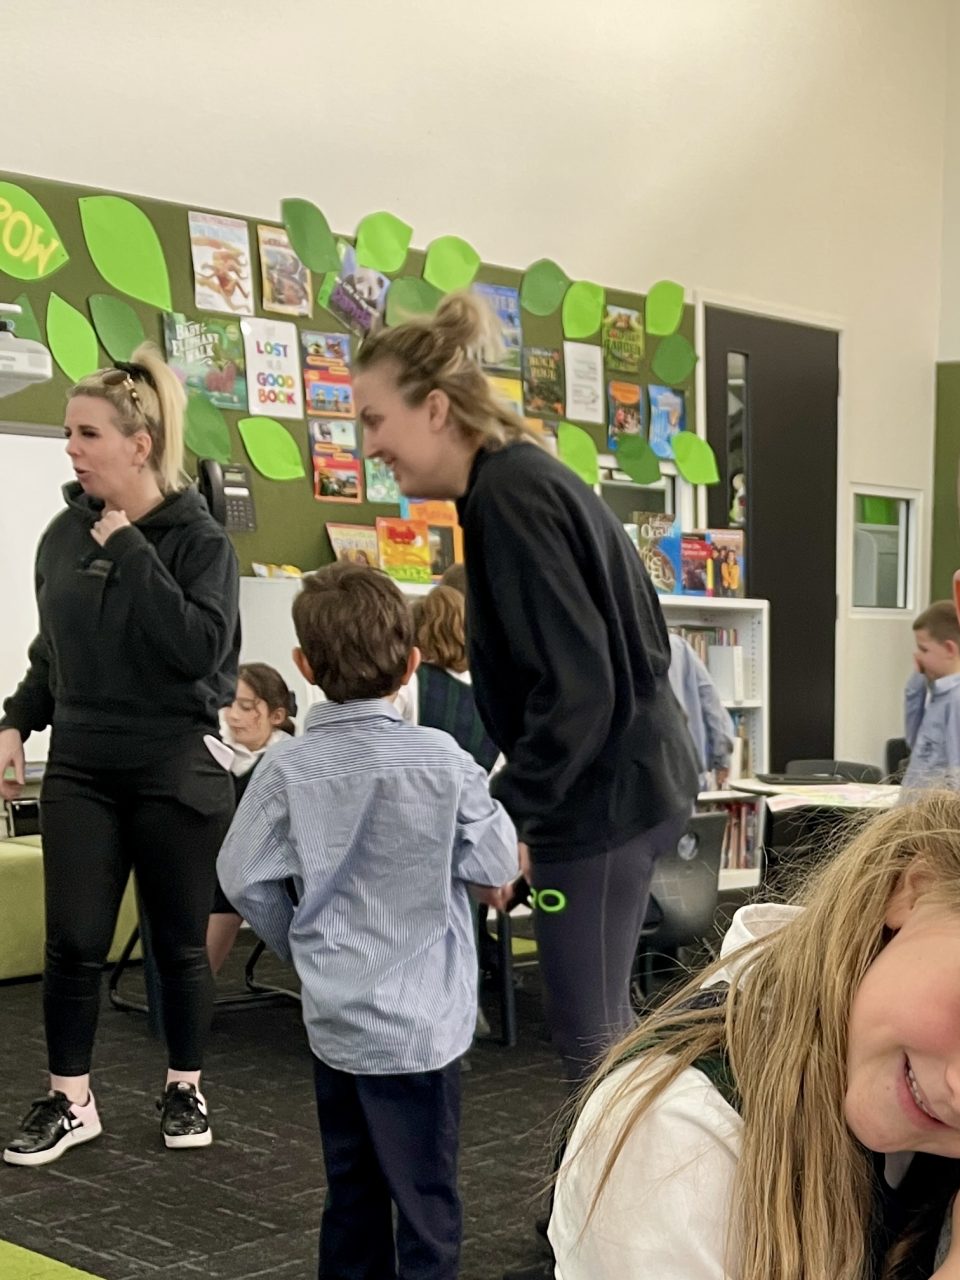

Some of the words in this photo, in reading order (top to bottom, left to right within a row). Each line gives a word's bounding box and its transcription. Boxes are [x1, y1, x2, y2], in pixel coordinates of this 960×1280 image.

[256, 341, 288, 357] LOST
[257, 372, 295, 389] GOOD
[259, 388, 296, 405] BOOK
